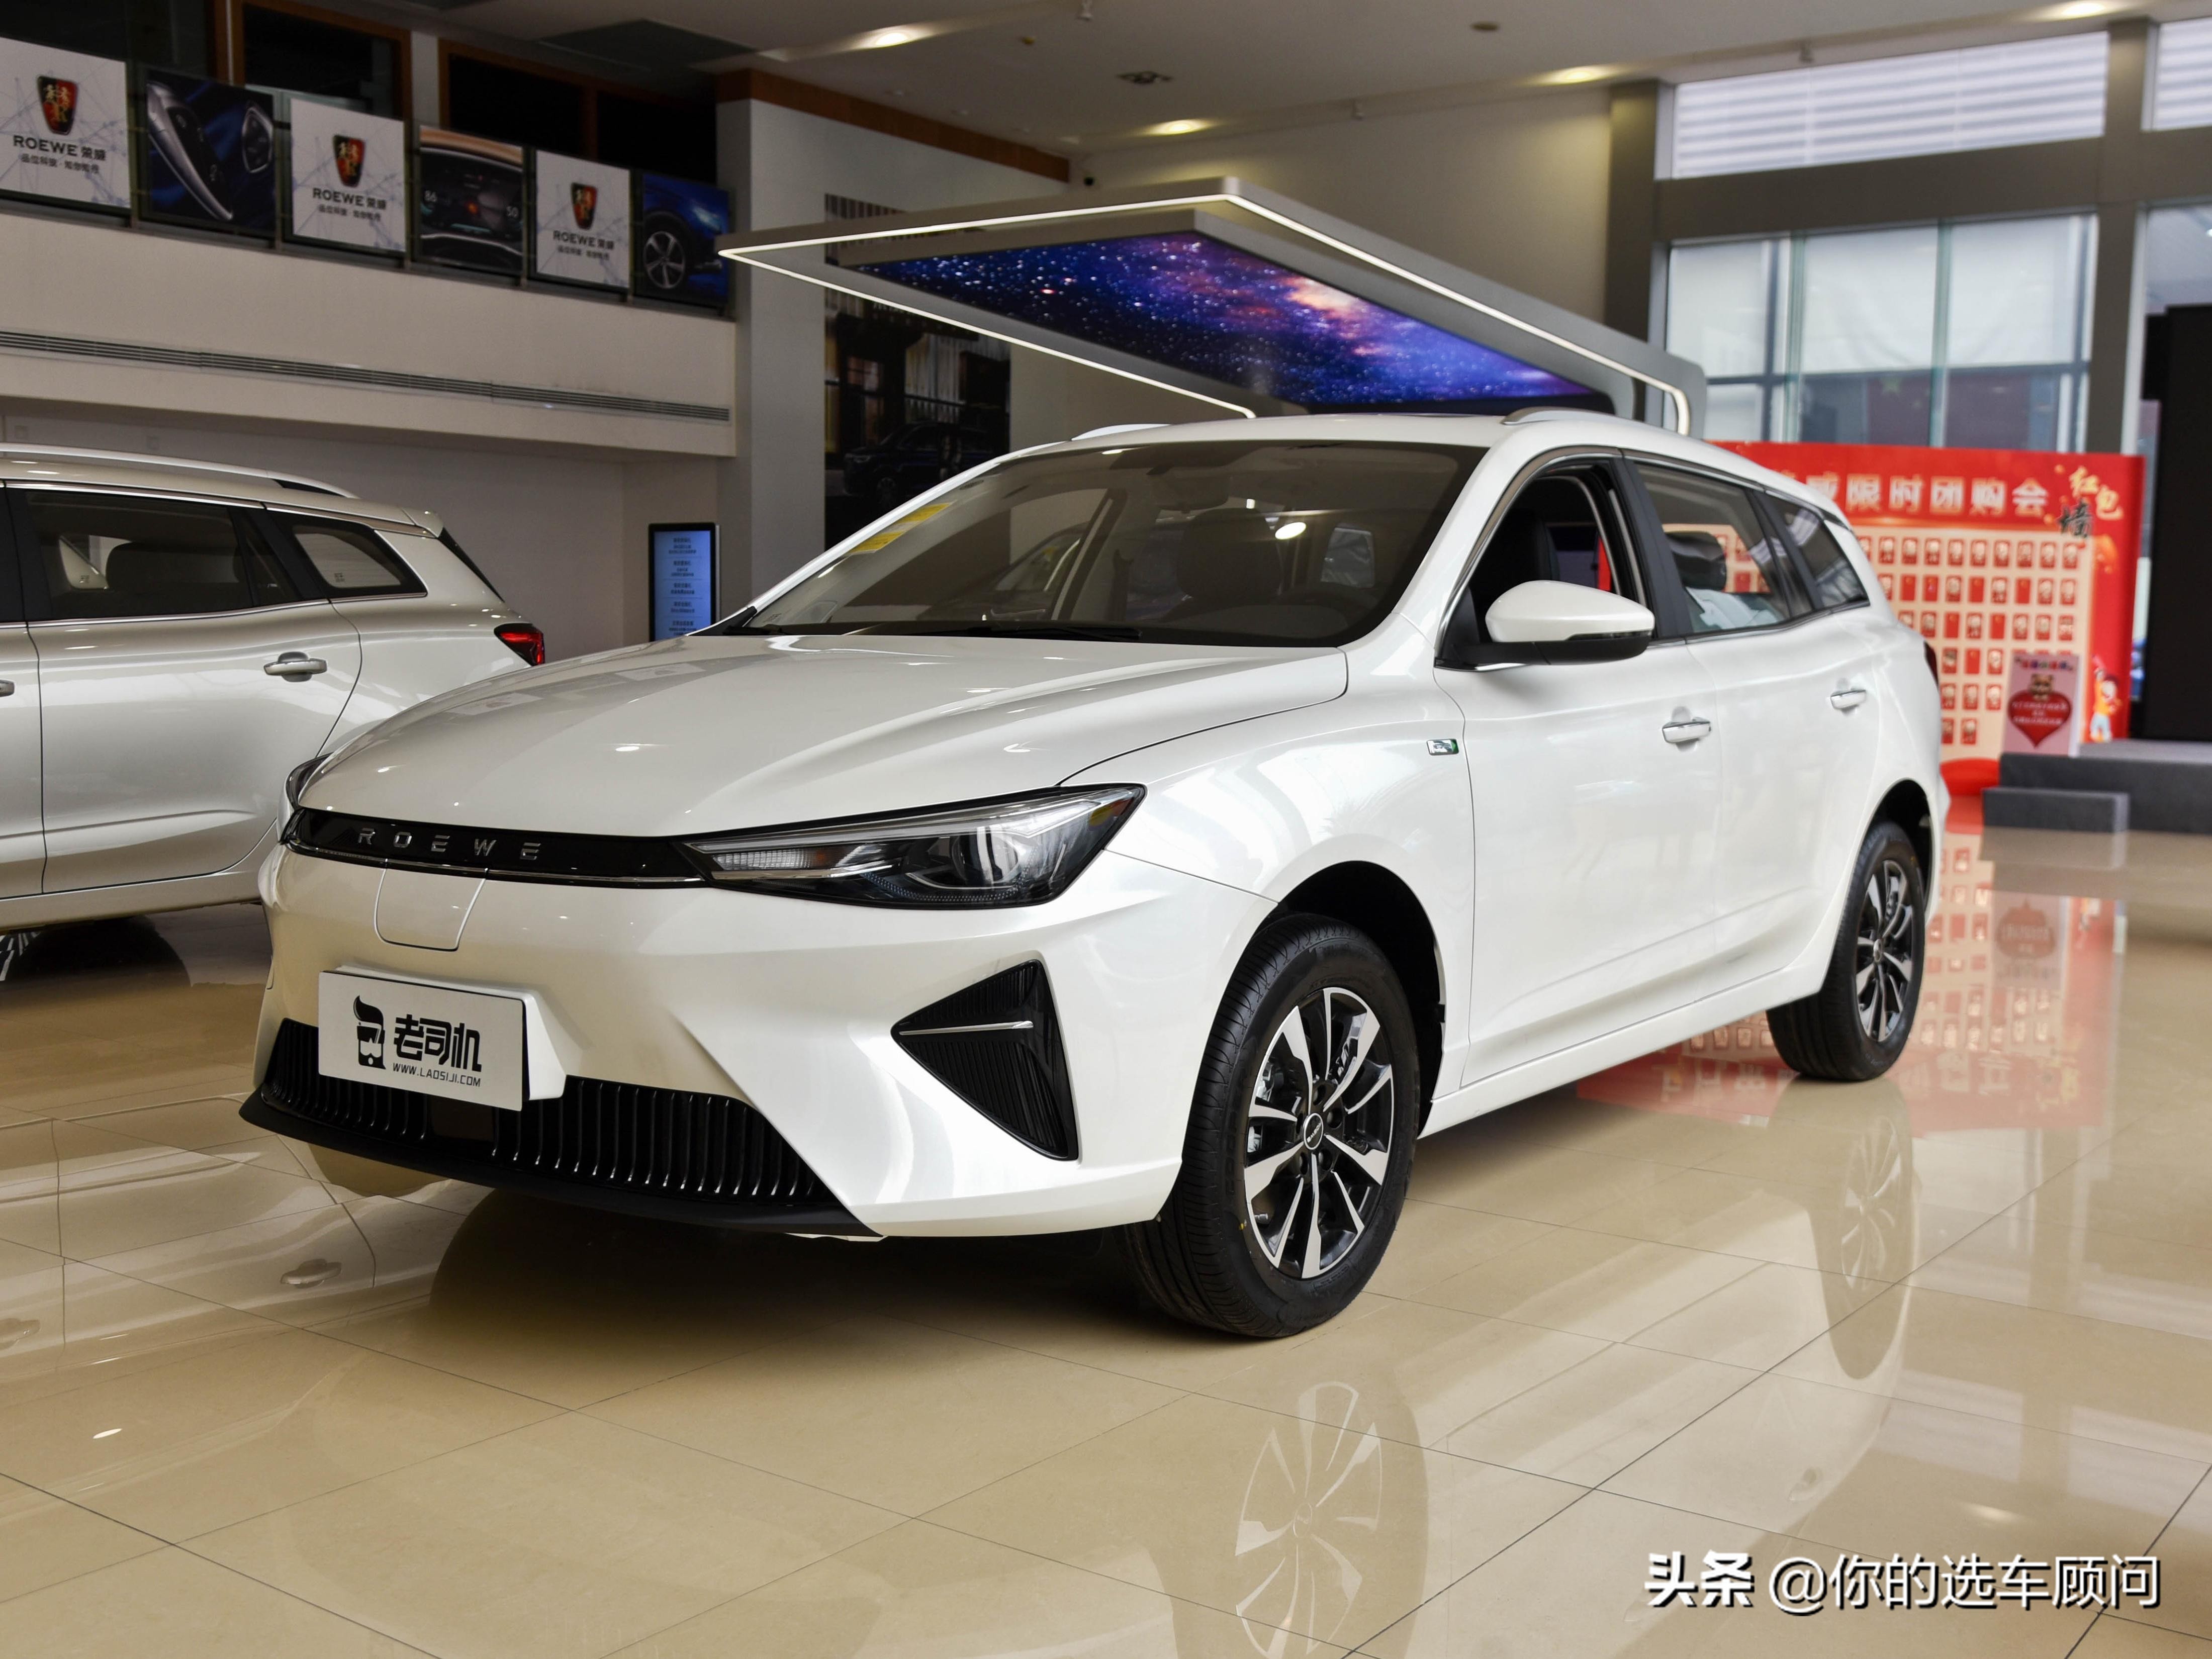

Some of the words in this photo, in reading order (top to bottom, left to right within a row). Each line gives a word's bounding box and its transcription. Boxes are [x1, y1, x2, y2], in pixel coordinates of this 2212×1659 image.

[13, 135, 77, 156] ROEWE
[313, 188, 363, 206] ROEWE
[554, 230, 596, 247] ROEWE
[357, 827, 541, 861] ROEWE
[394, 1013, 482, 1072] 老司机
[393, 1062, 481, 1087] WWW.LAOSIJI.COM
